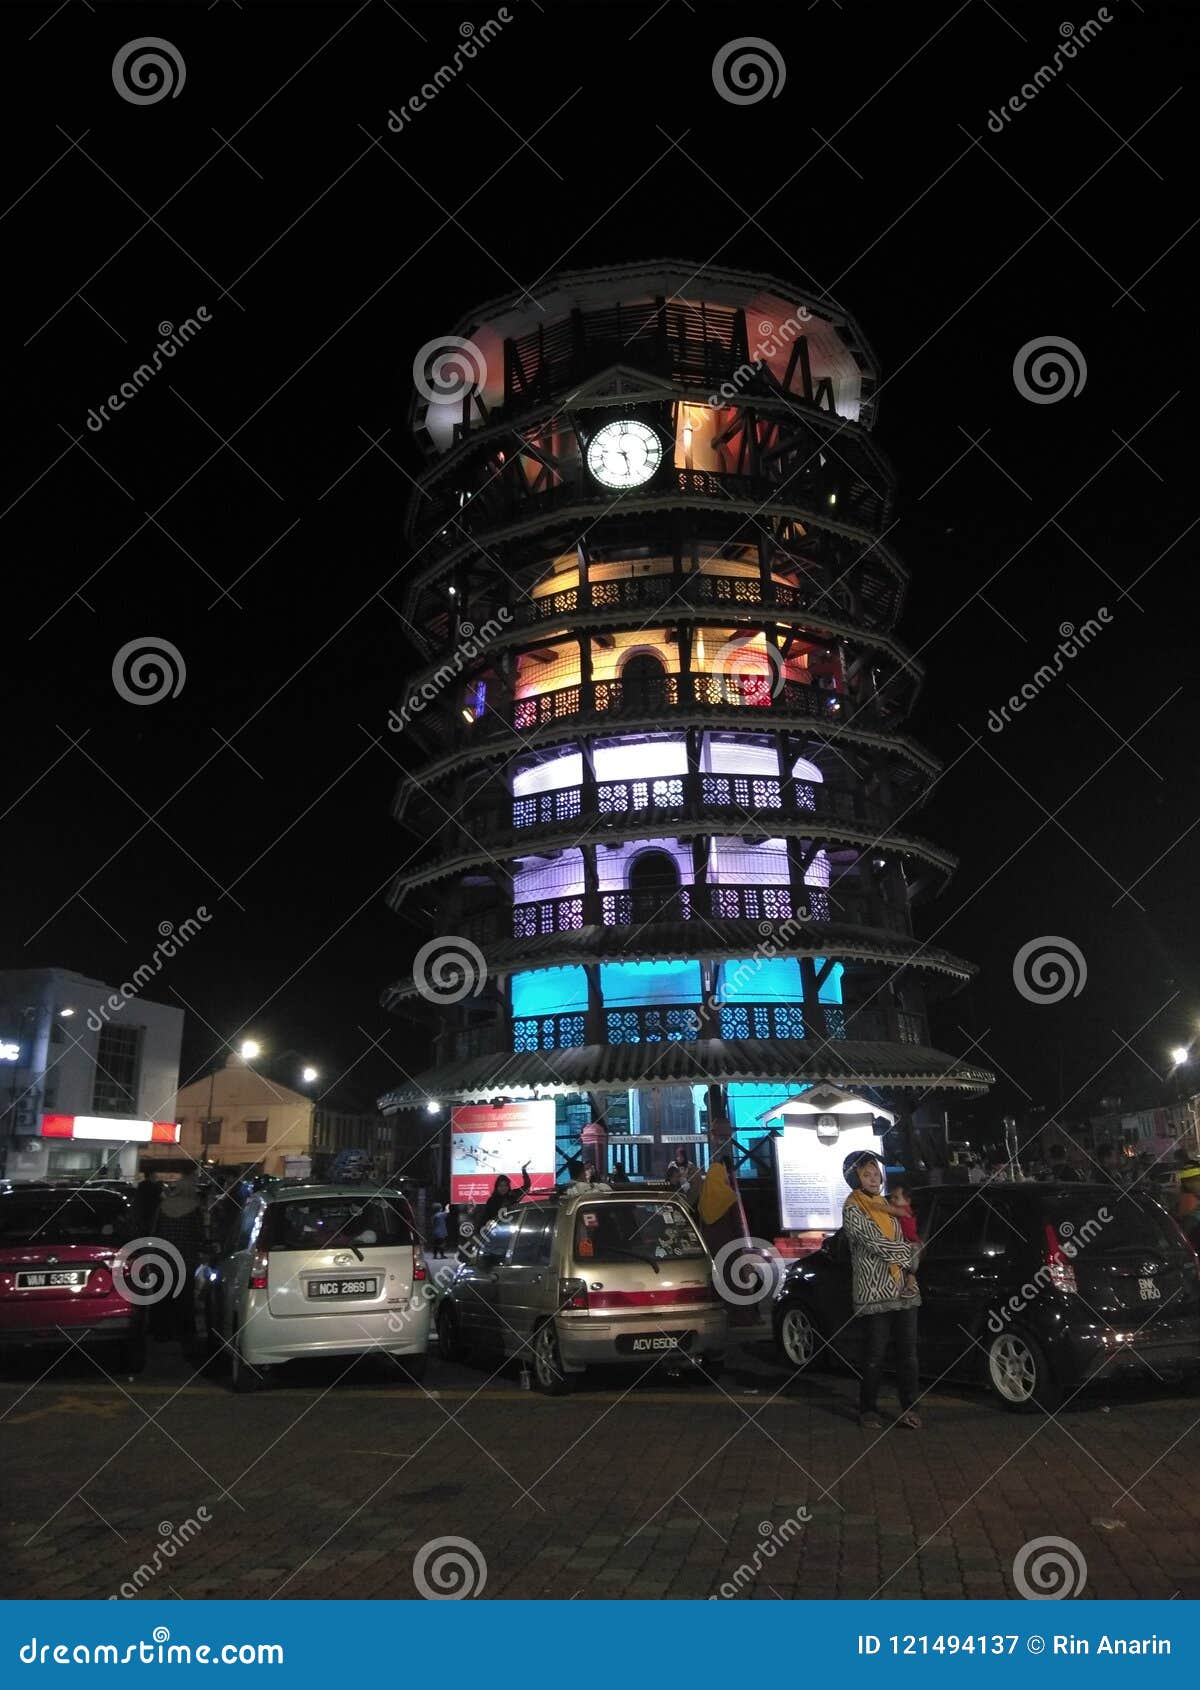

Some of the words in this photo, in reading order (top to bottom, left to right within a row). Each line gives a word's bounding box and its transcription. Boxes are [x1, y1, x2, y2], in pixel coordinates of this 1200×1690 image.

[320, 1283, 338, 1294] NCG
[341, 1281, 366, 1294] 2869
[632, 1339, 651, 1351] ACV
